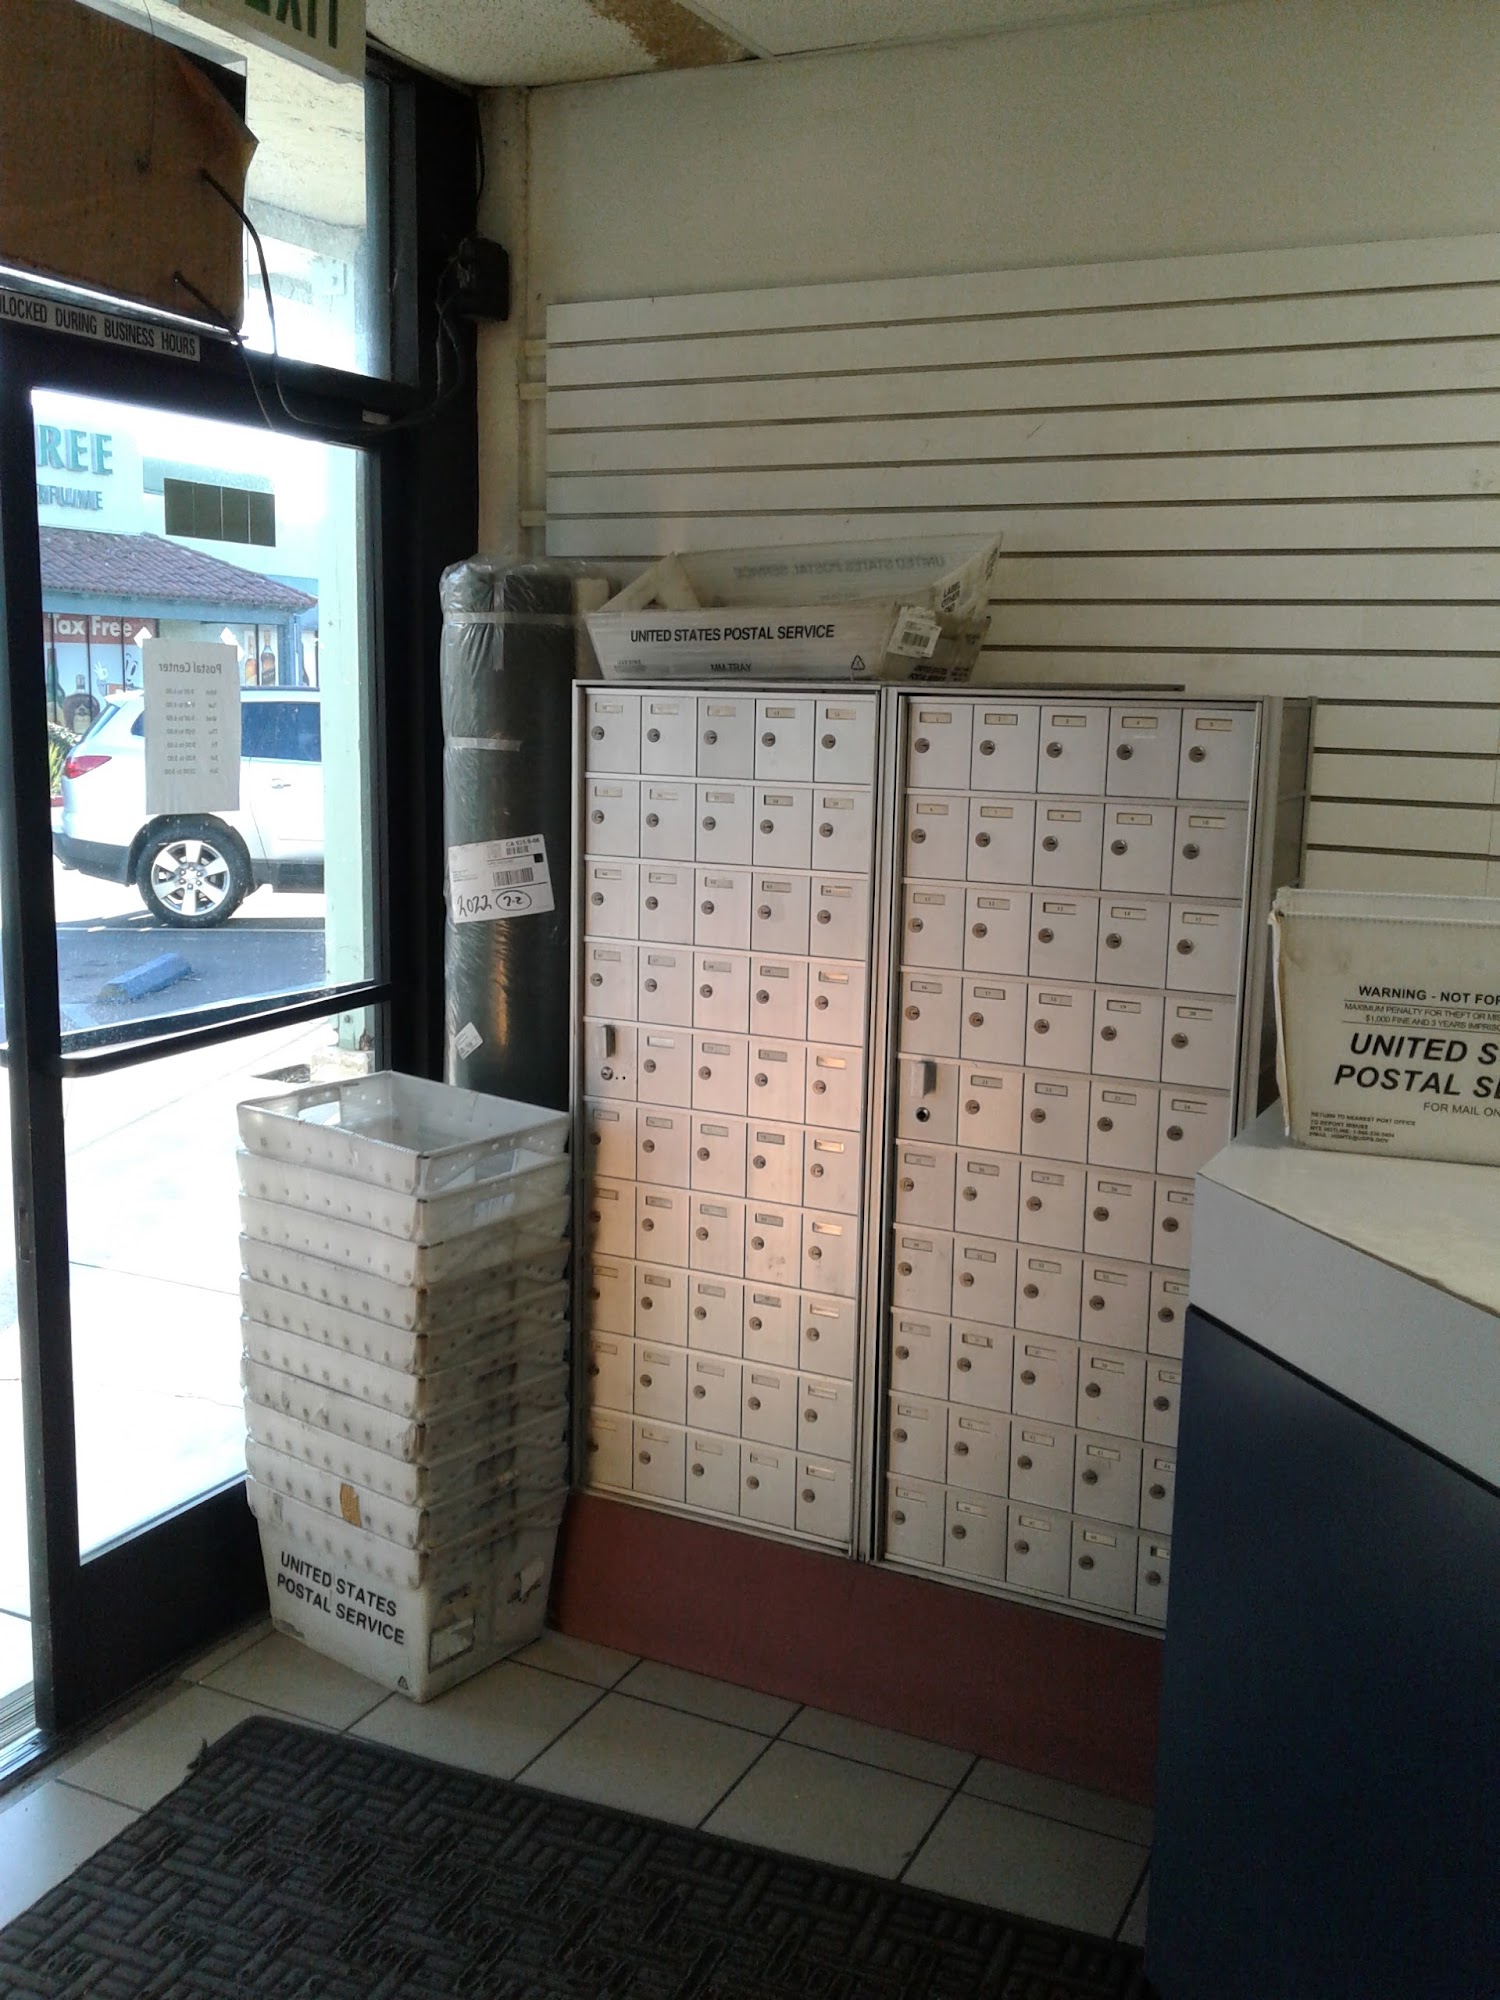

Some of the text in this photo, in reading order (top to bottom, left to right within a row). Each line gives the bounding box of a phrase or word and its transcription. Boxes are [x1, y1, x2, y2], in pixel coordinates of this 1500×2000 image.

[0, 294, 196, 356] LOCKED DURING BUSINESS HOURS
[49, 613, 133, 638] Tax Free
[630, 624, 835, 643] UNITED STATES POSTAL SERVICE
[729, 663, 752, 672] TRAY
[1358, 985, 1427, 1000] WARNING
[1440, 992, 1471, 1004] NOT
[1344, 1002, 1385, 1013] MAXIMUM
[1386, 1006, 1423, 1016] PENALTY
[1424, 1008, 1442, 1017] FOR
[1444, 1010, 1471, 1019] THEFT
[1472, 1012, 1486, 1020] OR
[1392, 1016, 1411, 1025] FINE
[1411, 1018, 1430, 1026] AND
[1437, 1020, 1467, 1029] YEARS
[1350, 1032, 1499, 1065] UNITED S
[1334, 1064, 1500, 1099] POSTAL S
[1423, 1102, 1449, 1113] FOR
[1452, 1104, 1480, 1116] MAIL
[281, 1550, 332, 1588] UNITED
[336, 1578, 397, 1617] STATES
[277, 1572, 405, 1645] POSTAL SERVICE
